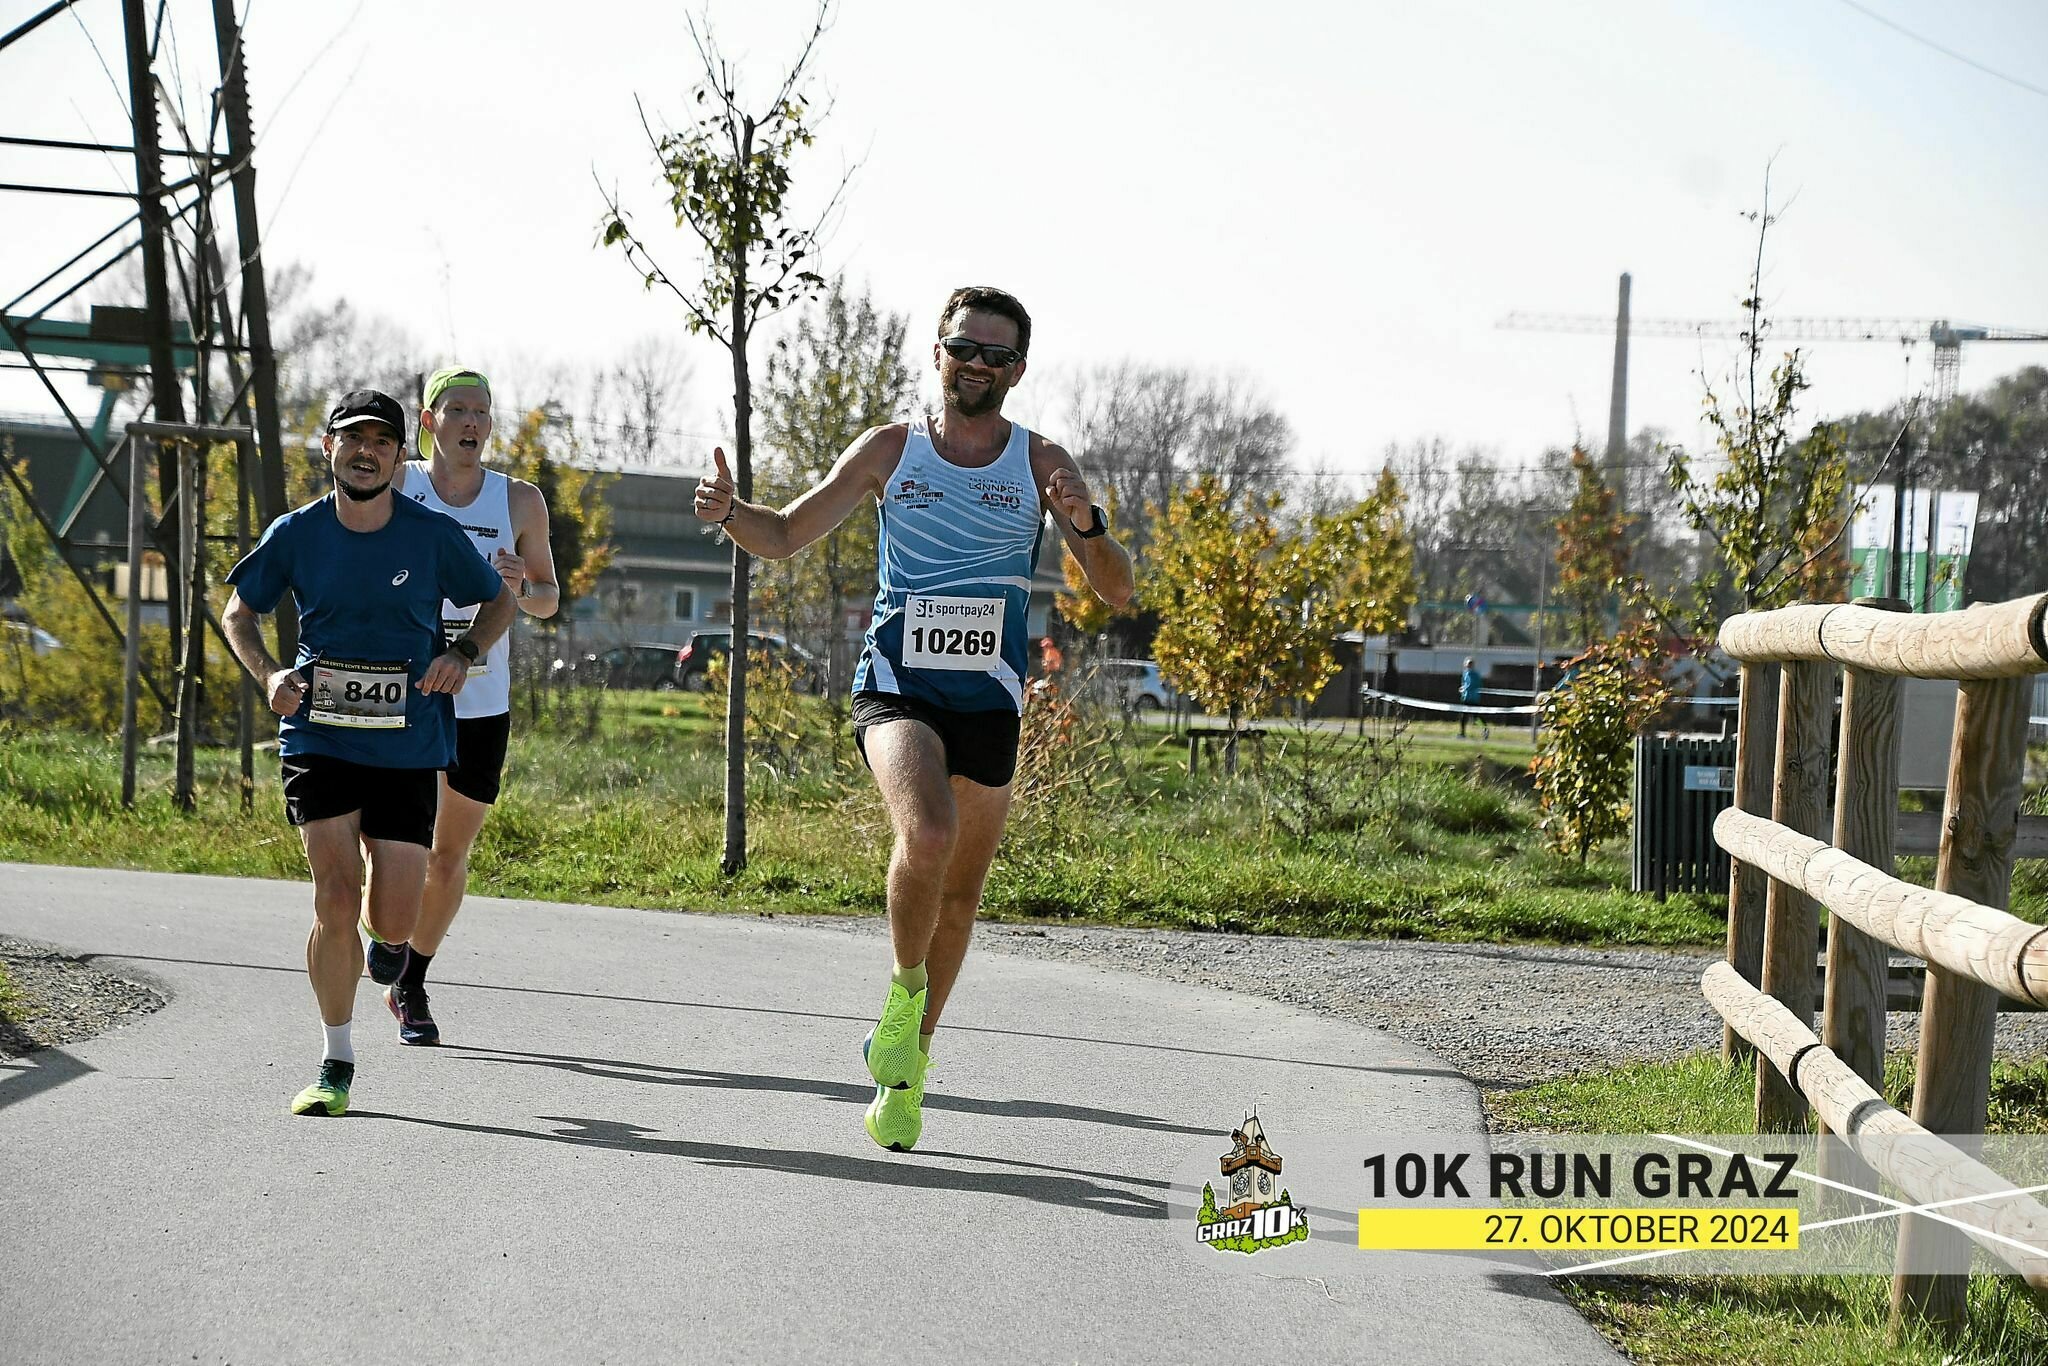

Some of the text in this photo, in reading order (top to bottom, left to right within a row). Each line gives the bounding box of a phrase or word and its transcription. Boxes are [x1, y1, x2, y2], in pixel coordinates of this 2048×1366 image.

[935, 603, 995, 618] sportpay24
[911, 627, 996, 656] 10269
[344, 680, 402, 704] 840
